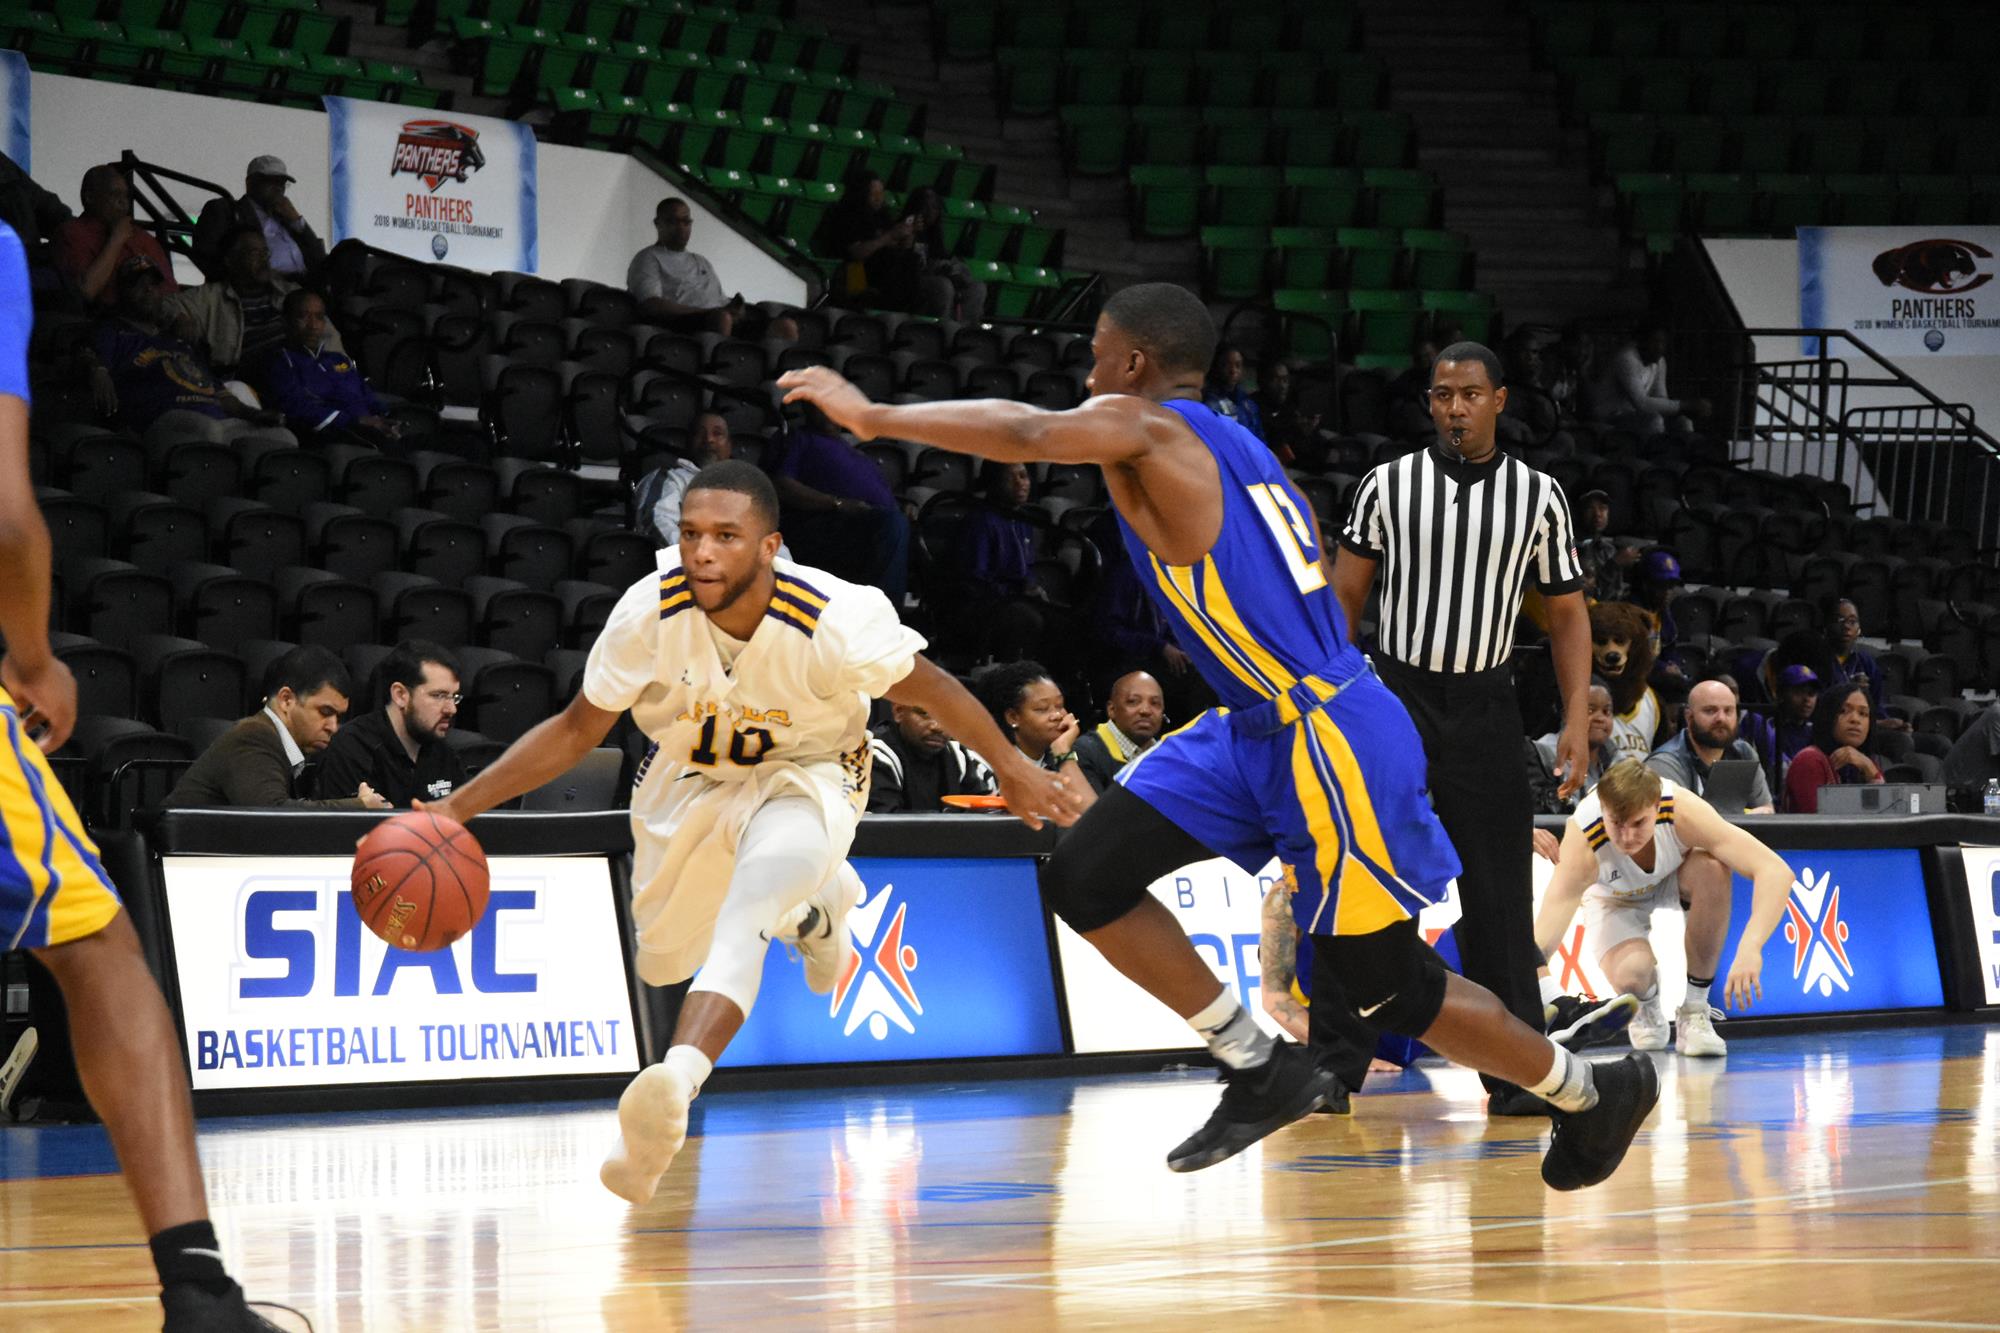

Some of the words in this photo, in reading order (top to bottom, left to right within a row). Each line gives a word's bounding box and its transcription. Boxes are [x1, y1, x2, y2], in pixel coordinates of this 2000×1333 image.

[394, 144, 461, 175] PANTHERS
[407, 194, 473, 223] PANTHERS
[374, 215, 390, 227] 2018
[422, 221, 461, 233] BASKETBALL
[463, 225, 503, 238] TOURNAMENT
[1892, 298, 1975, 319] PANTHERS
[1911, 319, 1962, 330] BASKETBALL
[1963, 318, 2000, 329] TOURNAM
[689, 712, 778, 768] 10
[197, 1026, 406, 1070] BASKETBALL
[419, 1019, 620, 1062] TOURNAMENT
